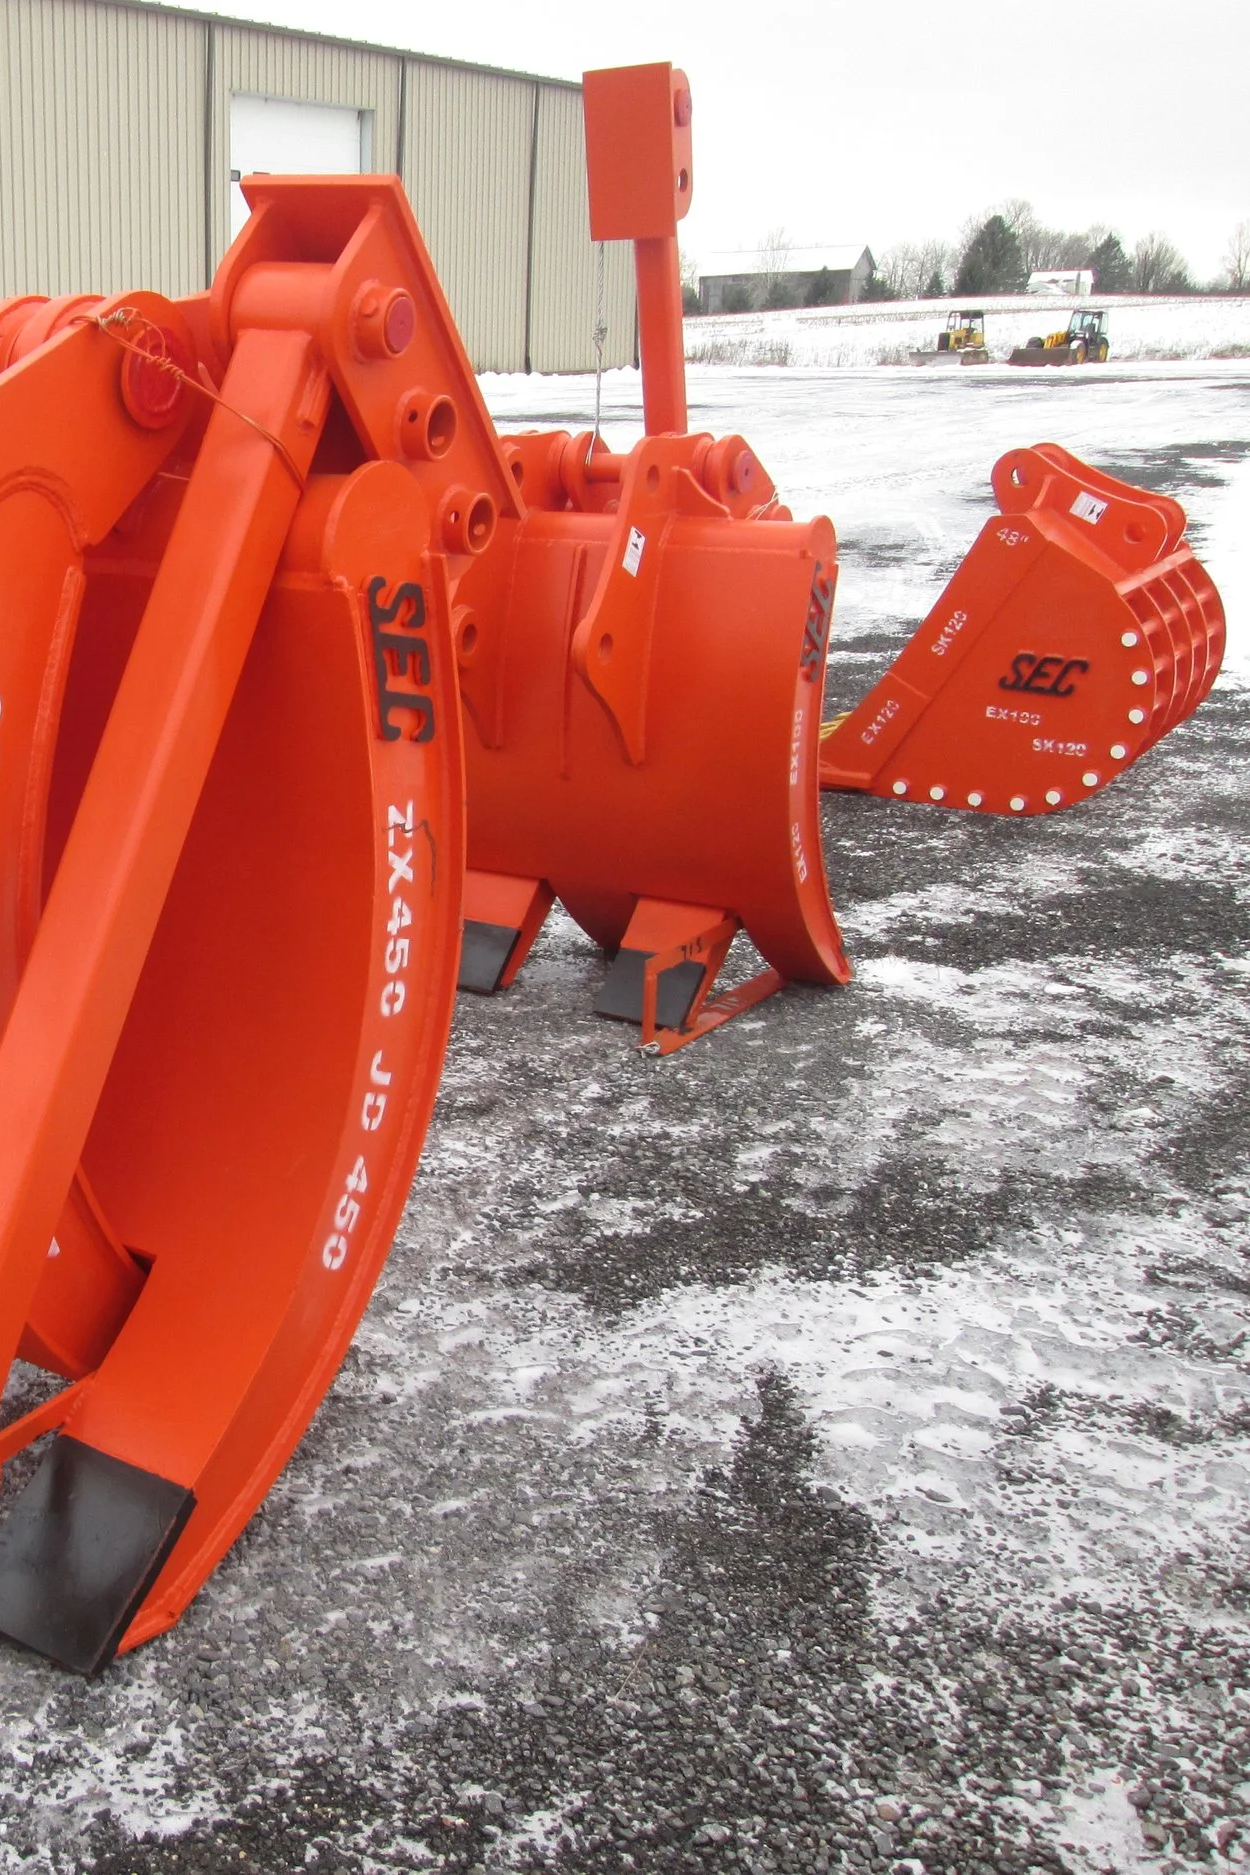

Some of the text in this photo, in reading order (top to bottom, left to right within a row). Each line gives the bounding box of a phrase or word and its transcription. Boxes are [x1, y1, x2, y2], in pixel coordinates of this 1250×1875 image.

[368, 575, 435, 743] SEC
[931, 610, 967, 656] SK120
[998, 652, 1090, 697] SEC
[322, 799, 414, 1271] ZX450 JD 450
